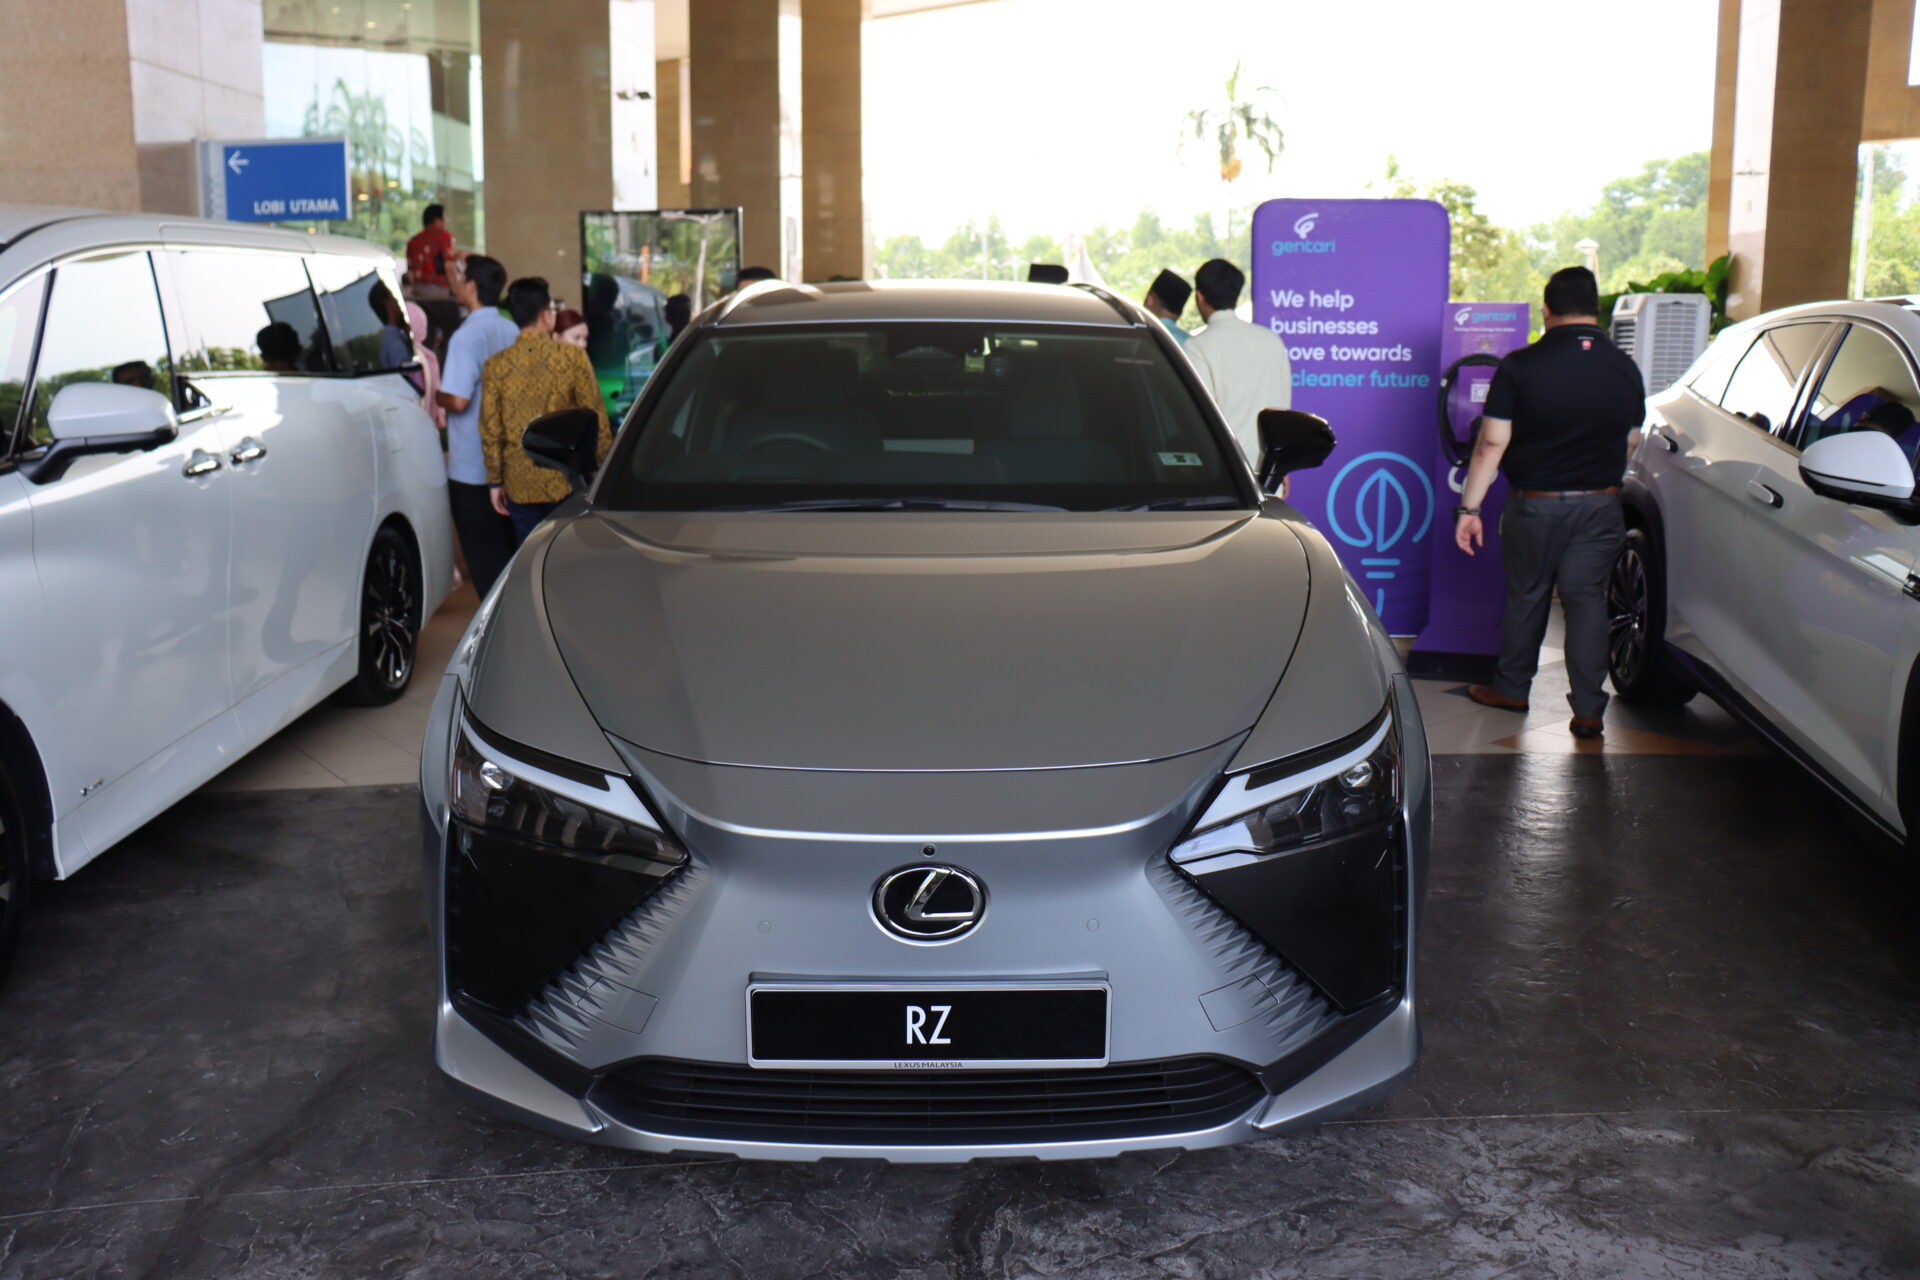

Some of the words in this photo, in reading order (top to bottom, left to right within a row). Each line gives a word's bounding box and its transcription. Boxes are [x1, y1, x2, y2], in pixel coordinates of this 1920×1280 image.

[254, 200, 286, 216] LOBI
[289, 197, 340, 214] UTAMA
[1271, 240, 1336, 257] gentari
[1270, 289, 1304, 308] We
[1309, 289, 1354, 312] help
[1270, 316, 1379, 335] businesses
[1330, 343, 1412, 362] towards
[1290, 368, 1364, 387] cleaner
[1370, 369, 1430, 388] future
[905, 1004, 952, 1045] RZ
[894, 1061, 921, 1069] LEXUS
[921, 1061, 963, 1069] MALAYSIA
